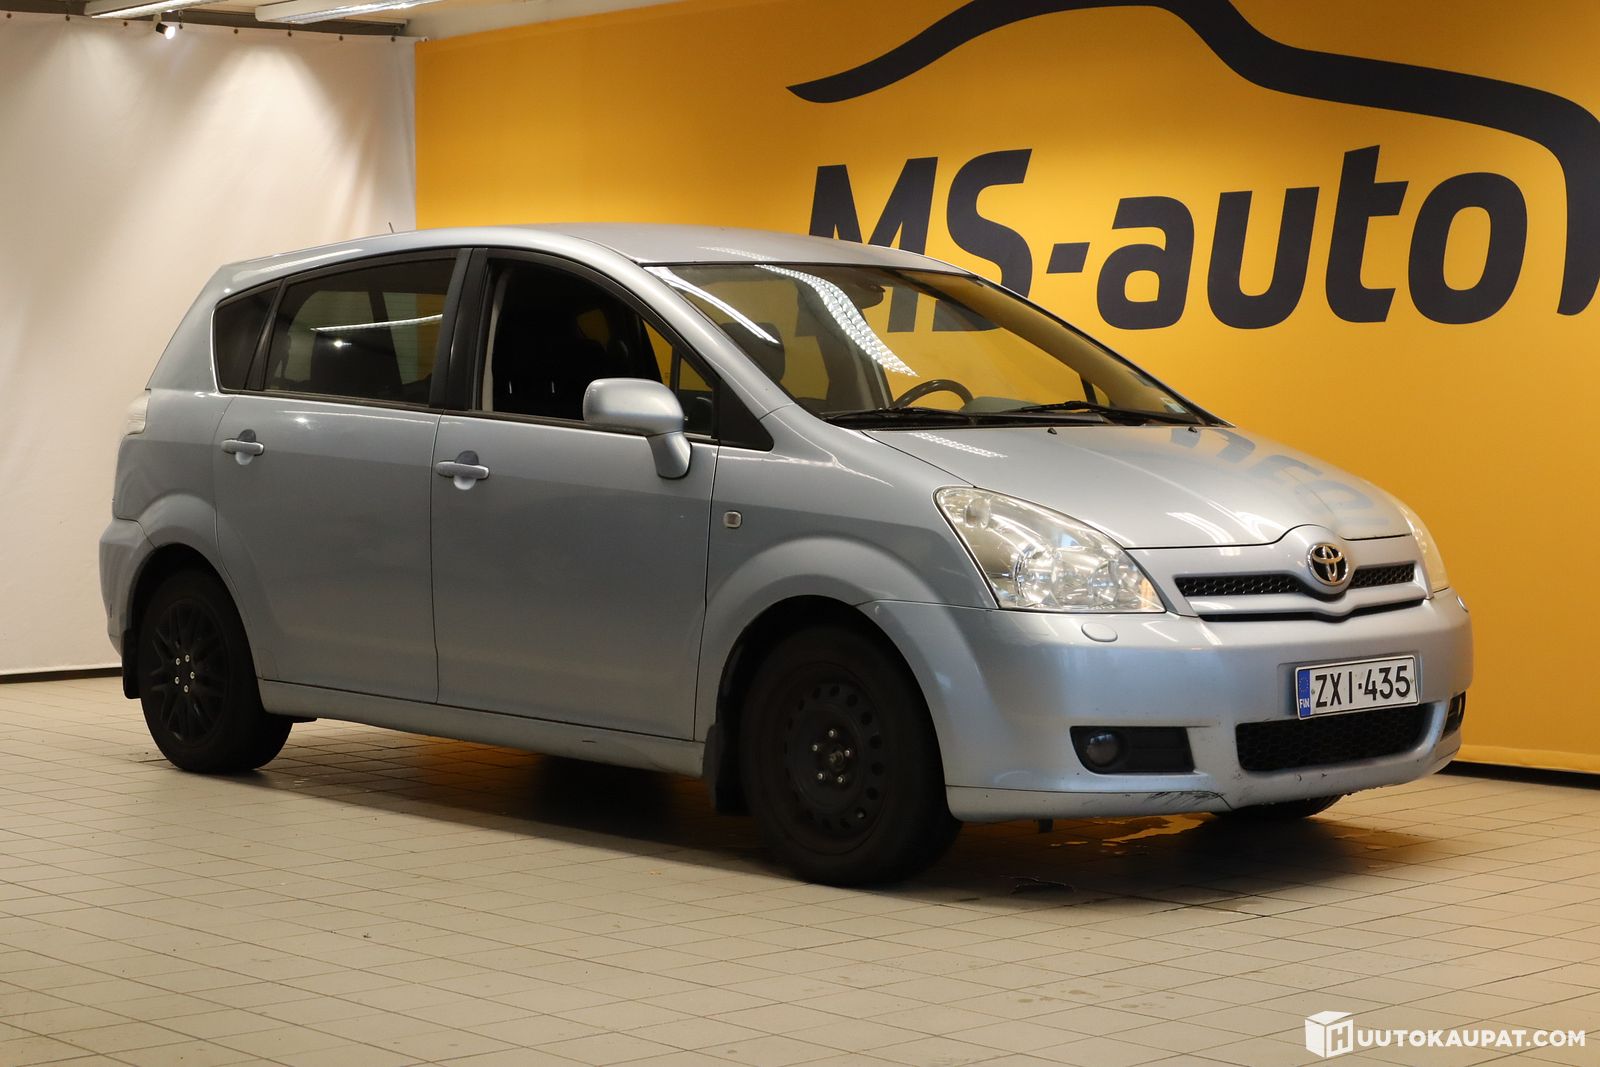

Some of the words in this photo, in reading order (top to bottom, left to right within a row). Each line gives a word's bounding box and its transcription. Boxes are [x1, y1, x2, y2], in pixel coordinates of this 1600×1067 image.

[797, 145, 1528, 332] MS-auto
[1300, 698, 1310, 709] FIN
[1315, 665, 1411, 708] ZXI-435
